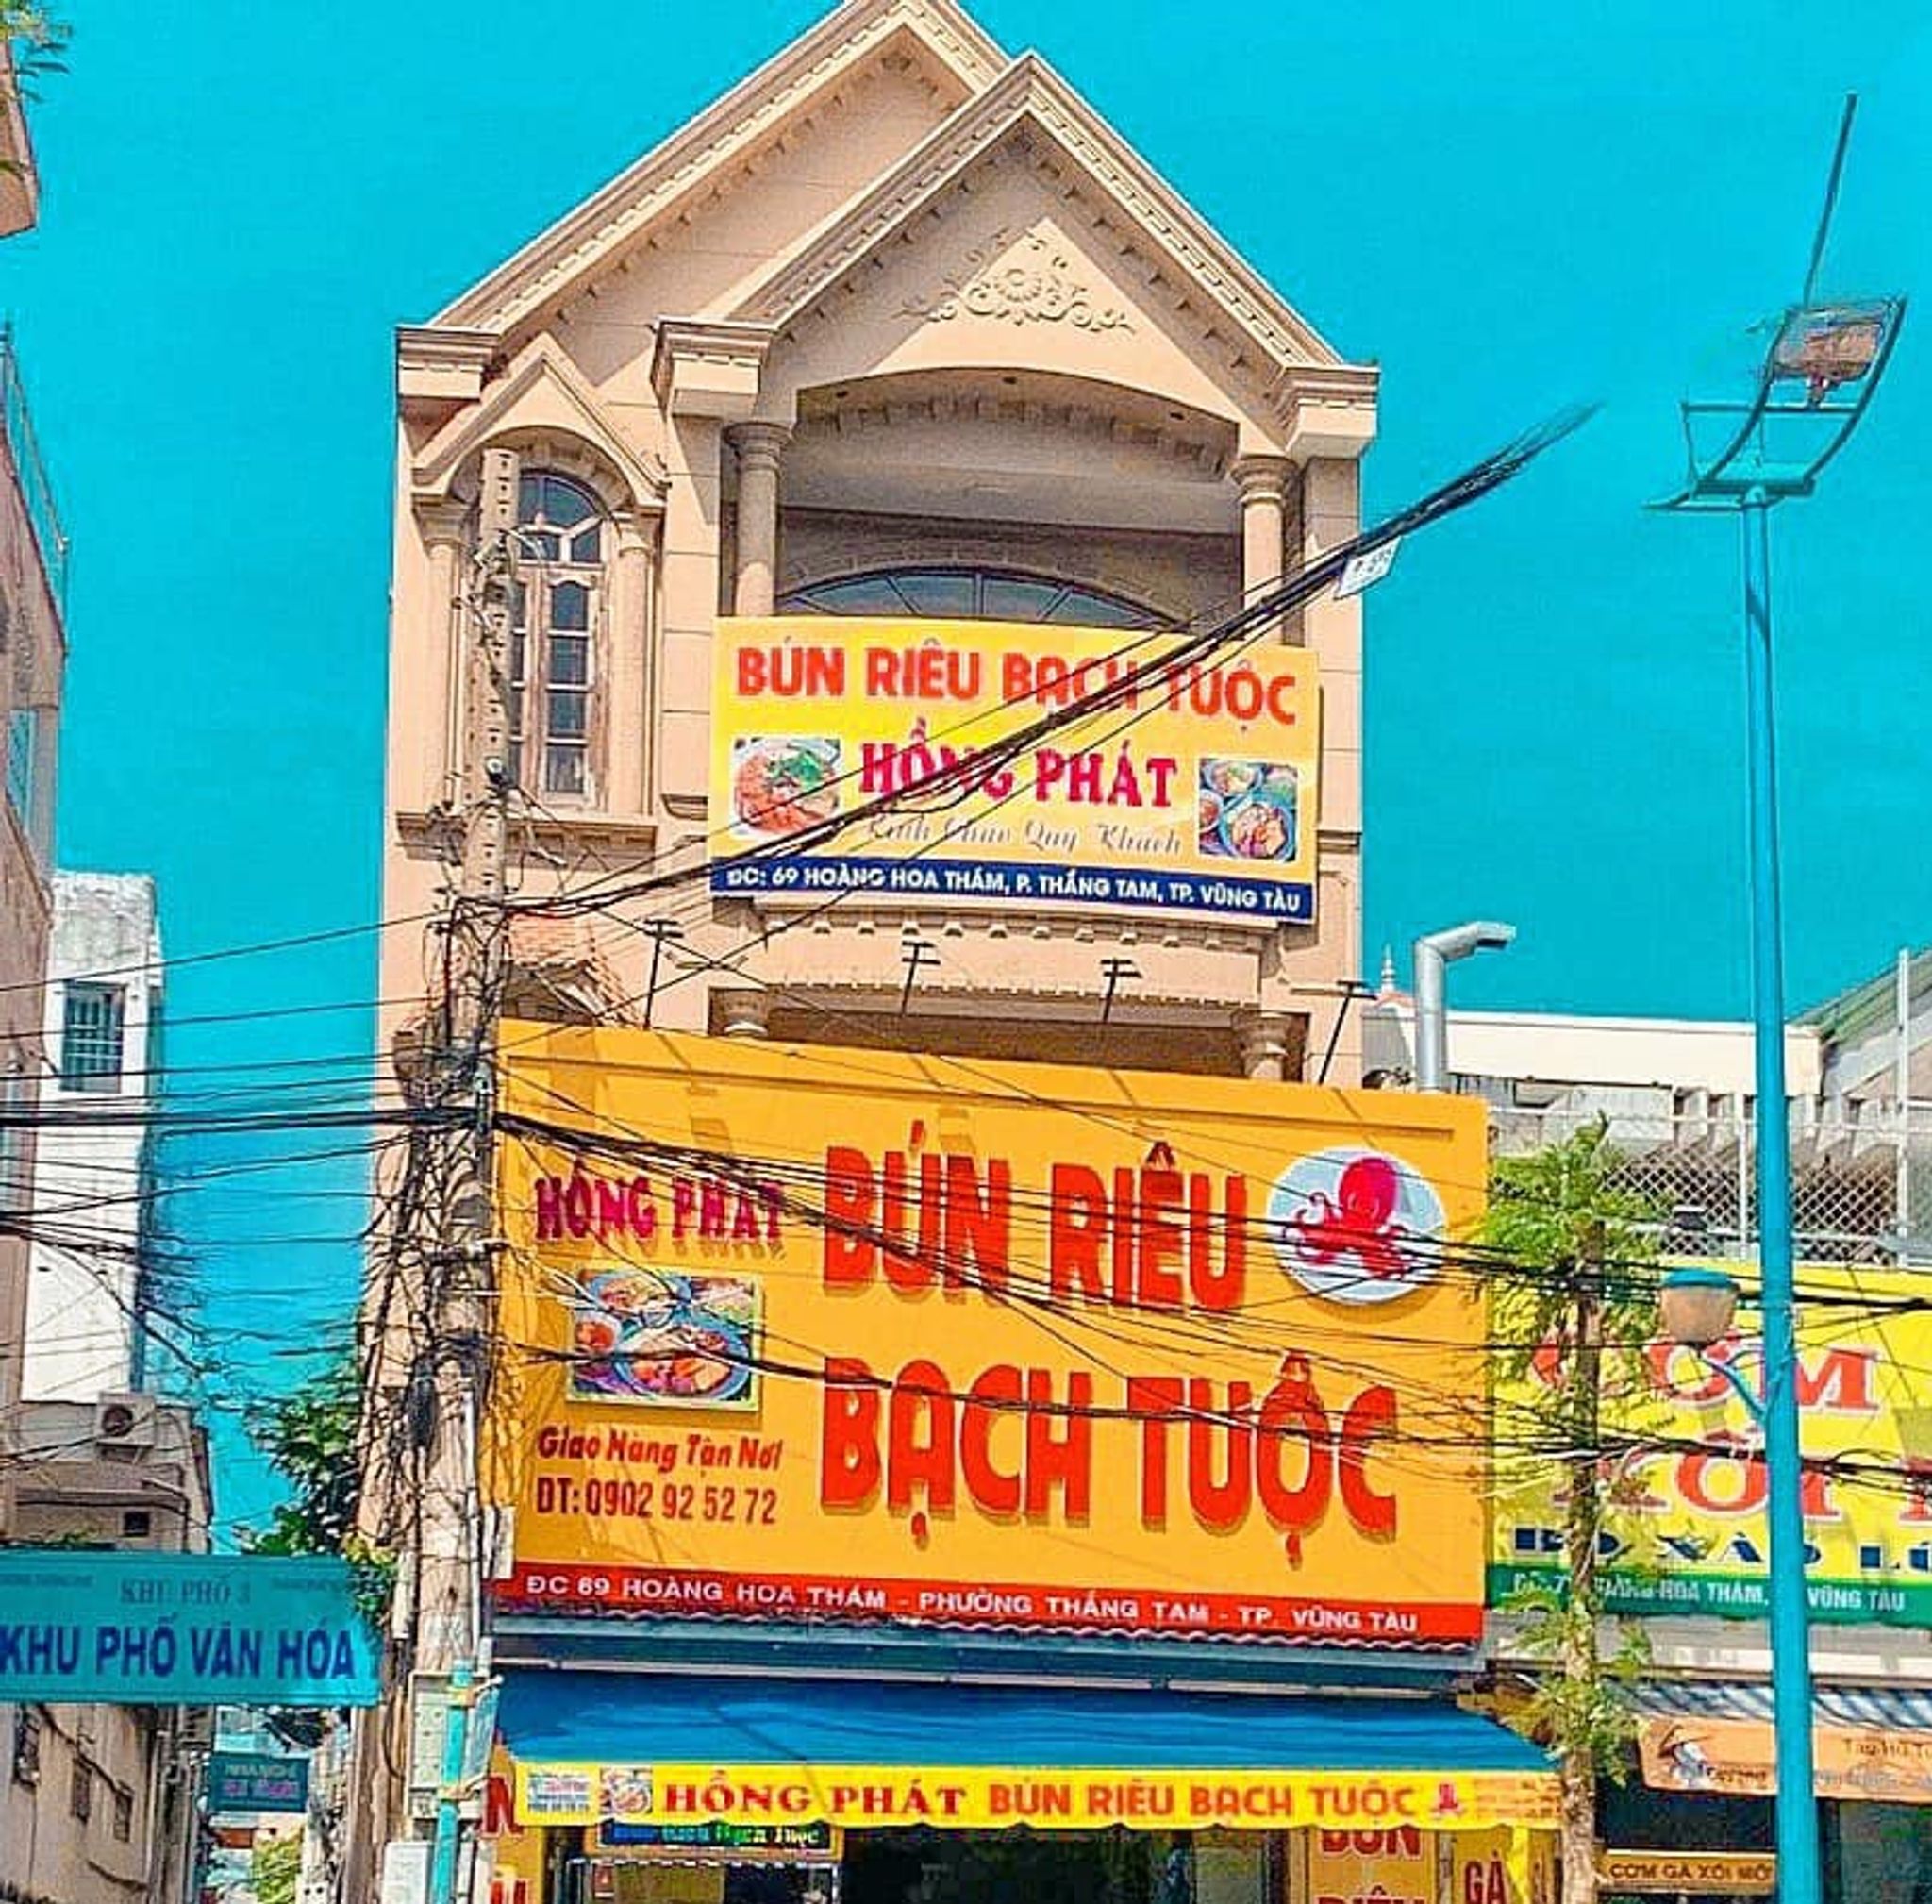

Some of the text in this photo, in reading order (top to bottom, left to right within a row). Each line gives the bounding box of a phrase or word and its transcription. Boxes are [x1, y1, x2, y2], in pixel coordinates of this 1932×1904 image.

[738, 635, 845, 697] BÚN
[865, 638, 980, 700] RIÊU
[1165, 658, 1296, 731] TUỘC
[1035, 739, 1177, 808] PHÁT
[772, 867, 799, 885] 69
[804, 862, 886, 887] HOÀNG
[891, 868, 939, 888] HOA
[1115, 878, 1164, 903] TAM,
[1169, 881, 1196, 903] TP.
[1201, 883, 1258, 909] VŨNG
[1264, 887, 1302, 912] TÀU
[823, 1119, 1248, 1310] BÚN RIÊU
[536, 1425, 602, 1460] Giao
[821, 1350, 1398, 1569] BẠCH TUỘC
[661, 1483, 695, 1520] 92
[703, 1486, 736, 1522] 52
[744, 1487, 778, 1525] 72
[622, 1571, 724, 1602] HOÀNG
[736, 1581, 797, 1604] HOA
[807, 1581, 887, 1610] THÁM
[1152, 1600, 1210, 1626] TAM
[1291, 1604, 1362, 1631] VŨNG
[1367, 1608, 1419, 1633] TÀU
[0, 1623, 81, 1676] KHU
[96, 1612, 178, 1678] PHỐ
[277, 1617, 356, 1679] HÓA
[663, 1769, 811, 1812] HỒNG
[830, 1778, 968, 1815] PHÁT
[989, 1777, 1072, 1816] BÚN
[1087, 1779, 1175, 1816] RIÊU
